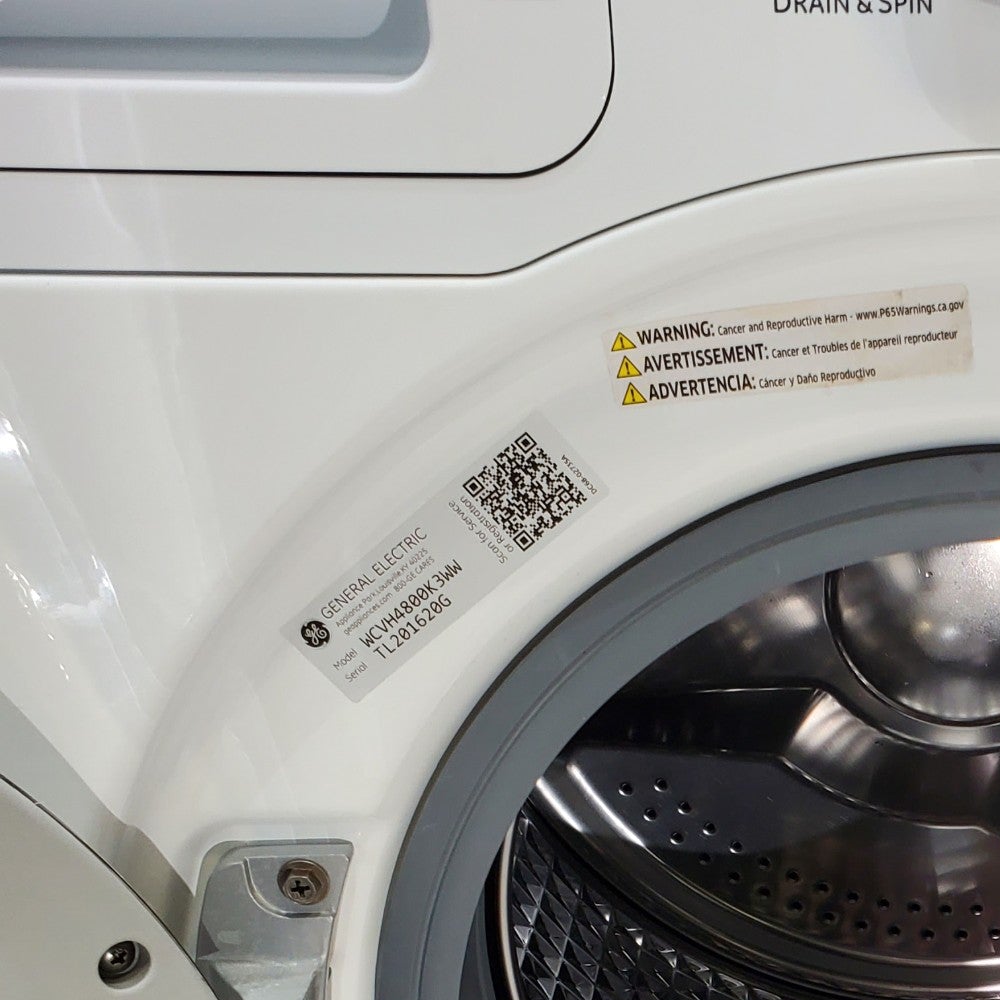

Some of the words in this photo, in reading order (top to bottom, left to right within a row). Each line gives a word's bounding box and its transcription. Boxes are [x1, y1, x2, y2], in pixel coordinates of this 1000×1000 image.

[773, 0, 850, 14] DRAIN
[856, 0, 873, 14] &
[878, 0, 933, 14] SPIN
[635, 320, 715, 345] WARNING:
[717, 322, 745, 336] Cancer
[747, 320, 763, 332] and
[765, 314, 823, 332] Reproductive
[823, 311, 847, 324] Harm
[641, 342, 769, 373] AVERTISSEMENT:
[771, 345, 800, 358] Cancer
[801, 344, 811, 355] et
[811, 340, 848, 354] Troubles
[849, 339, 861, 350] de
[862, 334, 902, 351] l'appareil
[903, 328, 958, 346] reproducteur
[646, 372, 756, 400] ADVERTENCIA:
[758, 375, 786, 389] Cáncer
[788, 377, 796, 387] y
[796, 372, 818, 385] Daño
[819, 365, 876, 384] Reproductivo
[445, 499, 477, 531] Service
[458, 493, 507, 544] Registration
[473, 528, 488, 544] for
[503, 541, 514, 553] or
[413, 555, 435, 575] CARES
[484, 540, 508, 564] Scan
[318, 569, 376, 621] GENERAL
[370, 525, 428, 577] ELECTRIC
[334, 601, 364, 628] Appliance
[407, 547, 428, 566] 40225
[332, 647, 358, 671] Model
[343, 660, 368, 683] Serial
